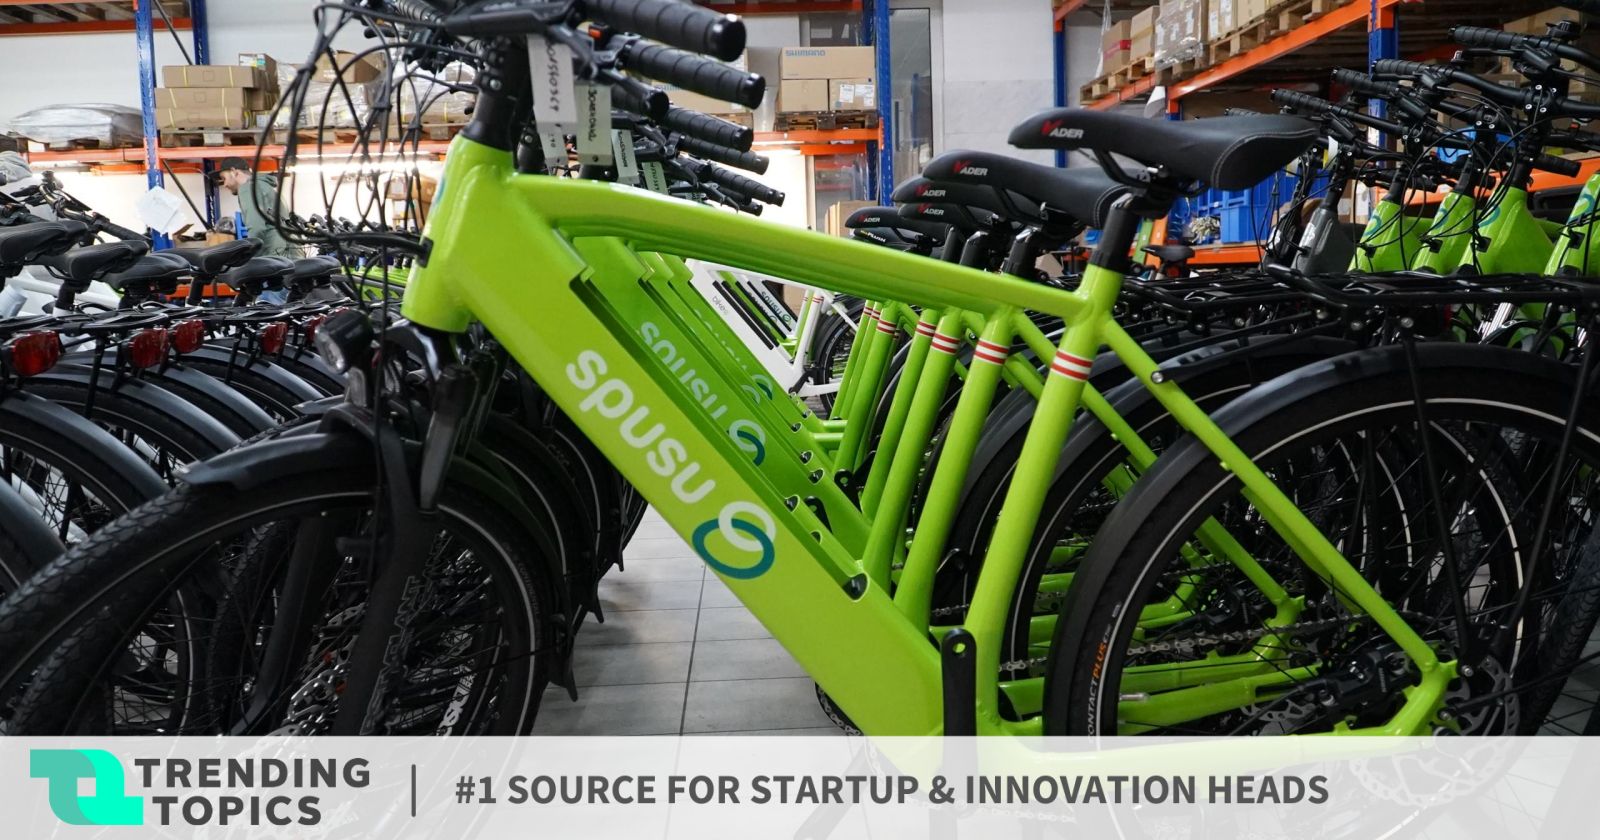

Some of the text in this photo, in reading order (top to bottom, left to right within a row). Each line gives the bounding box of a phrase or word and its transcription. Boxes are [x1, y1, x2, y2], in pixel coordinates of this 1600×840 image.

[1041, 120, 1084, 139] VADER
[952, 160, 988, 176] VADER
[915, 183, 946, 197] VADER
[916, 203, 944, 216] VADER
[566, 350, 716, 504] spusu
